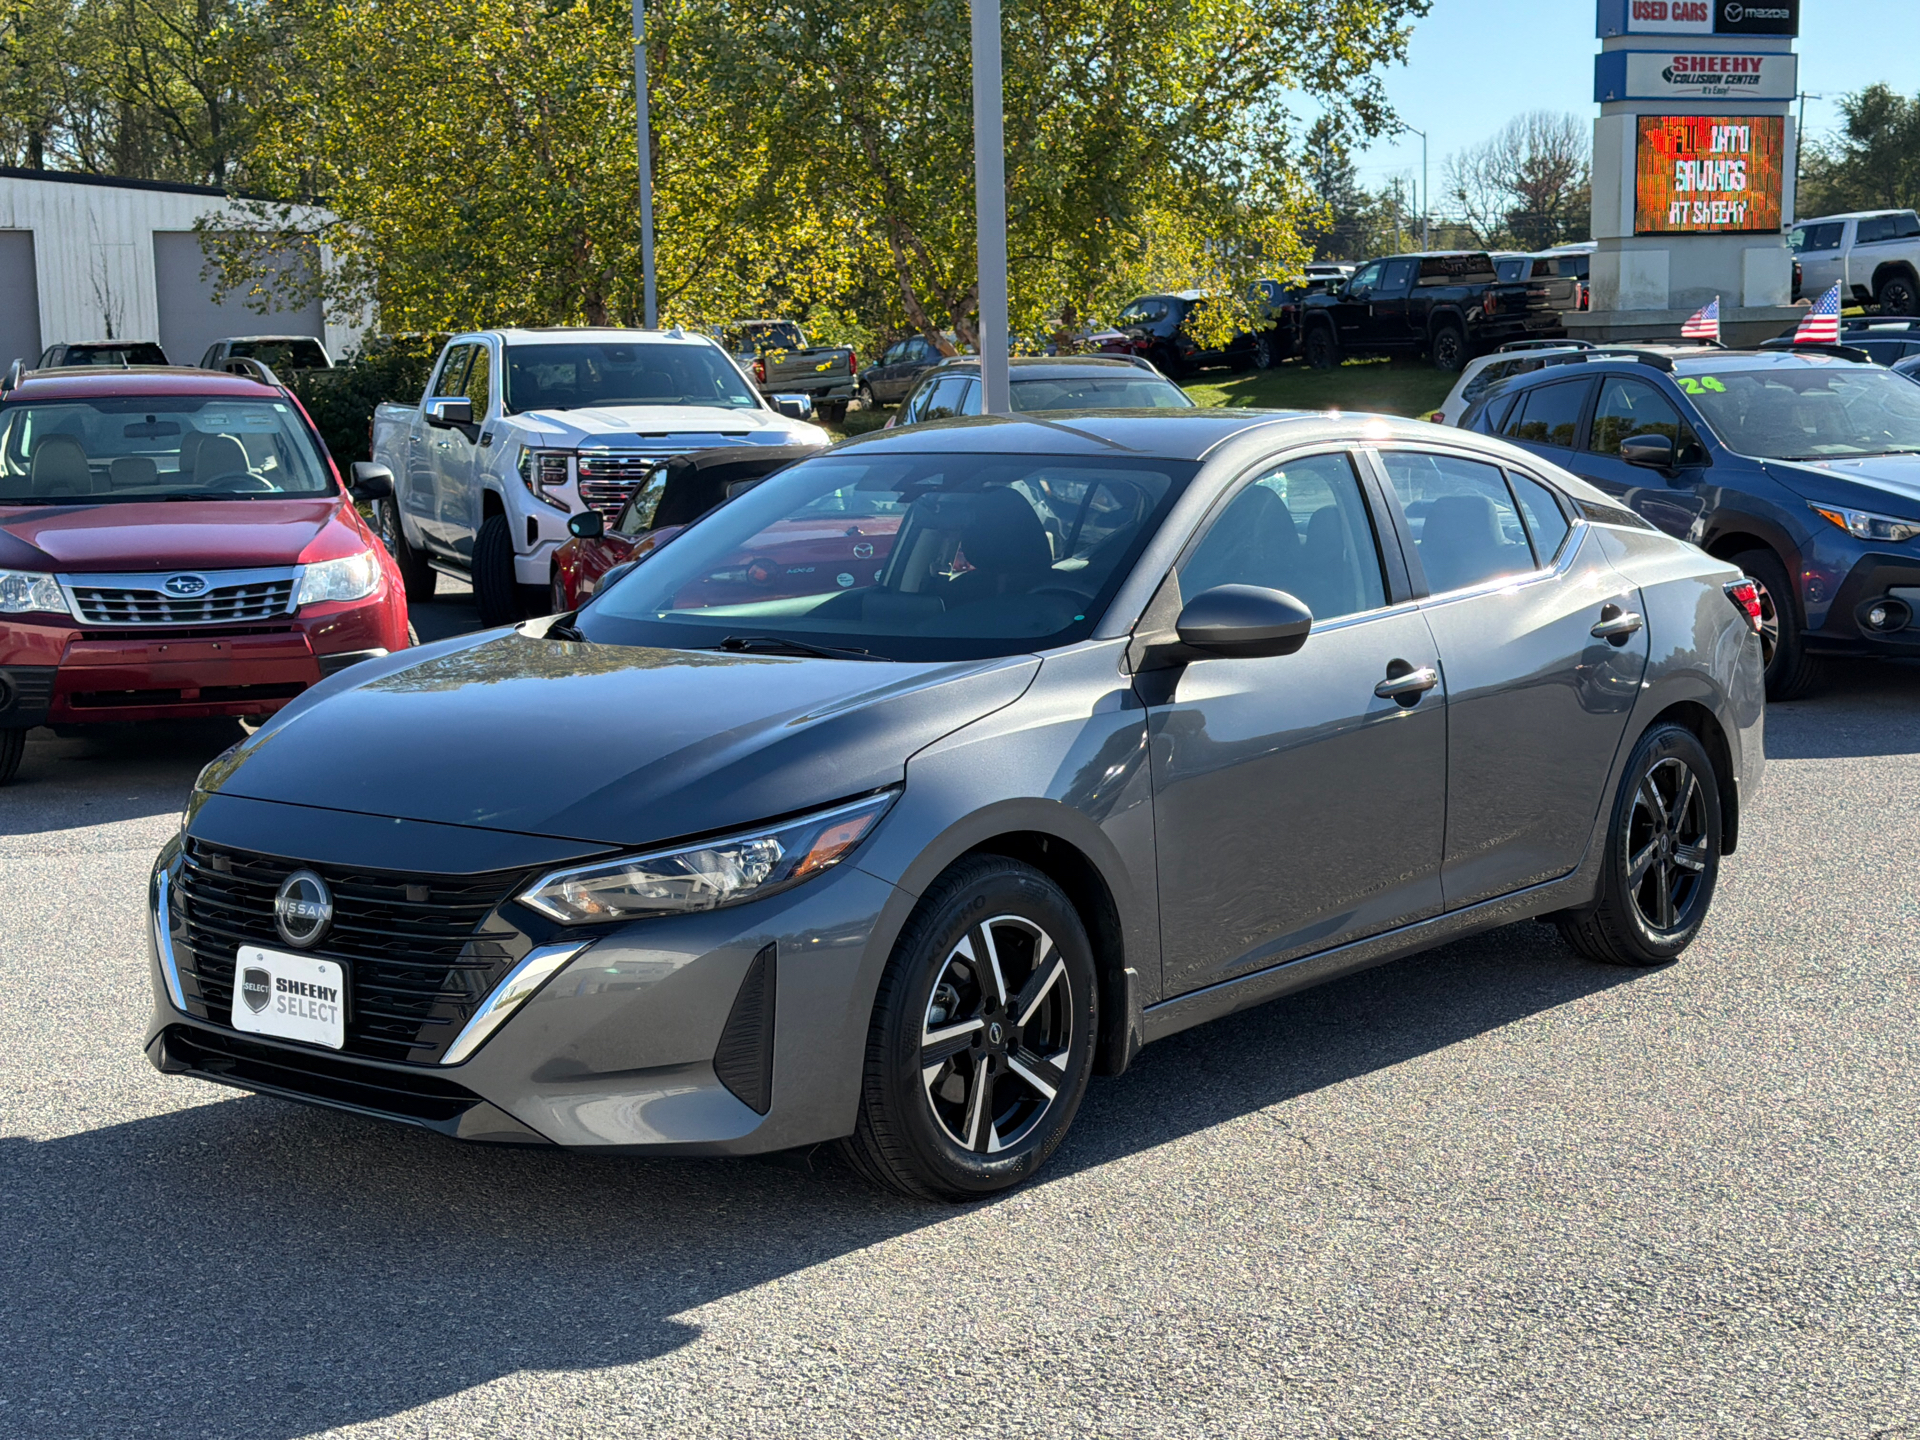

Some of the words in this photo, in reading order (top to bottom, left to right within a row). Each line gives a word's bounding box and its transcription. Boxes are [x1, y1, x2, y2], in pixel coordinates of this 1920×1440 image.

[1633, 0, 1668, 20] USED
[1672, 1, 1708, 22] CARS
[1744, 8, 1790, 19] mazda
[1673, 56, 1764, 73] SHEEHY
[1673, 73, 1723, 85] COLLISION
[1724, 74, 1762, 85] CENTER
[1702, 86, 1712, 94] It's
[1713, 86, 1731, 96] Easy!
[1675, 160, 1747, 192] SAVINGS
[1669, 201, 1690, 224] AT
[277, 899, 329, 918] NISSAN
[243, 981, 269, 994] SELECT
[276, 977, 338, 1003] SHEEHY
[276, 994, 338, 1025] SELECT
